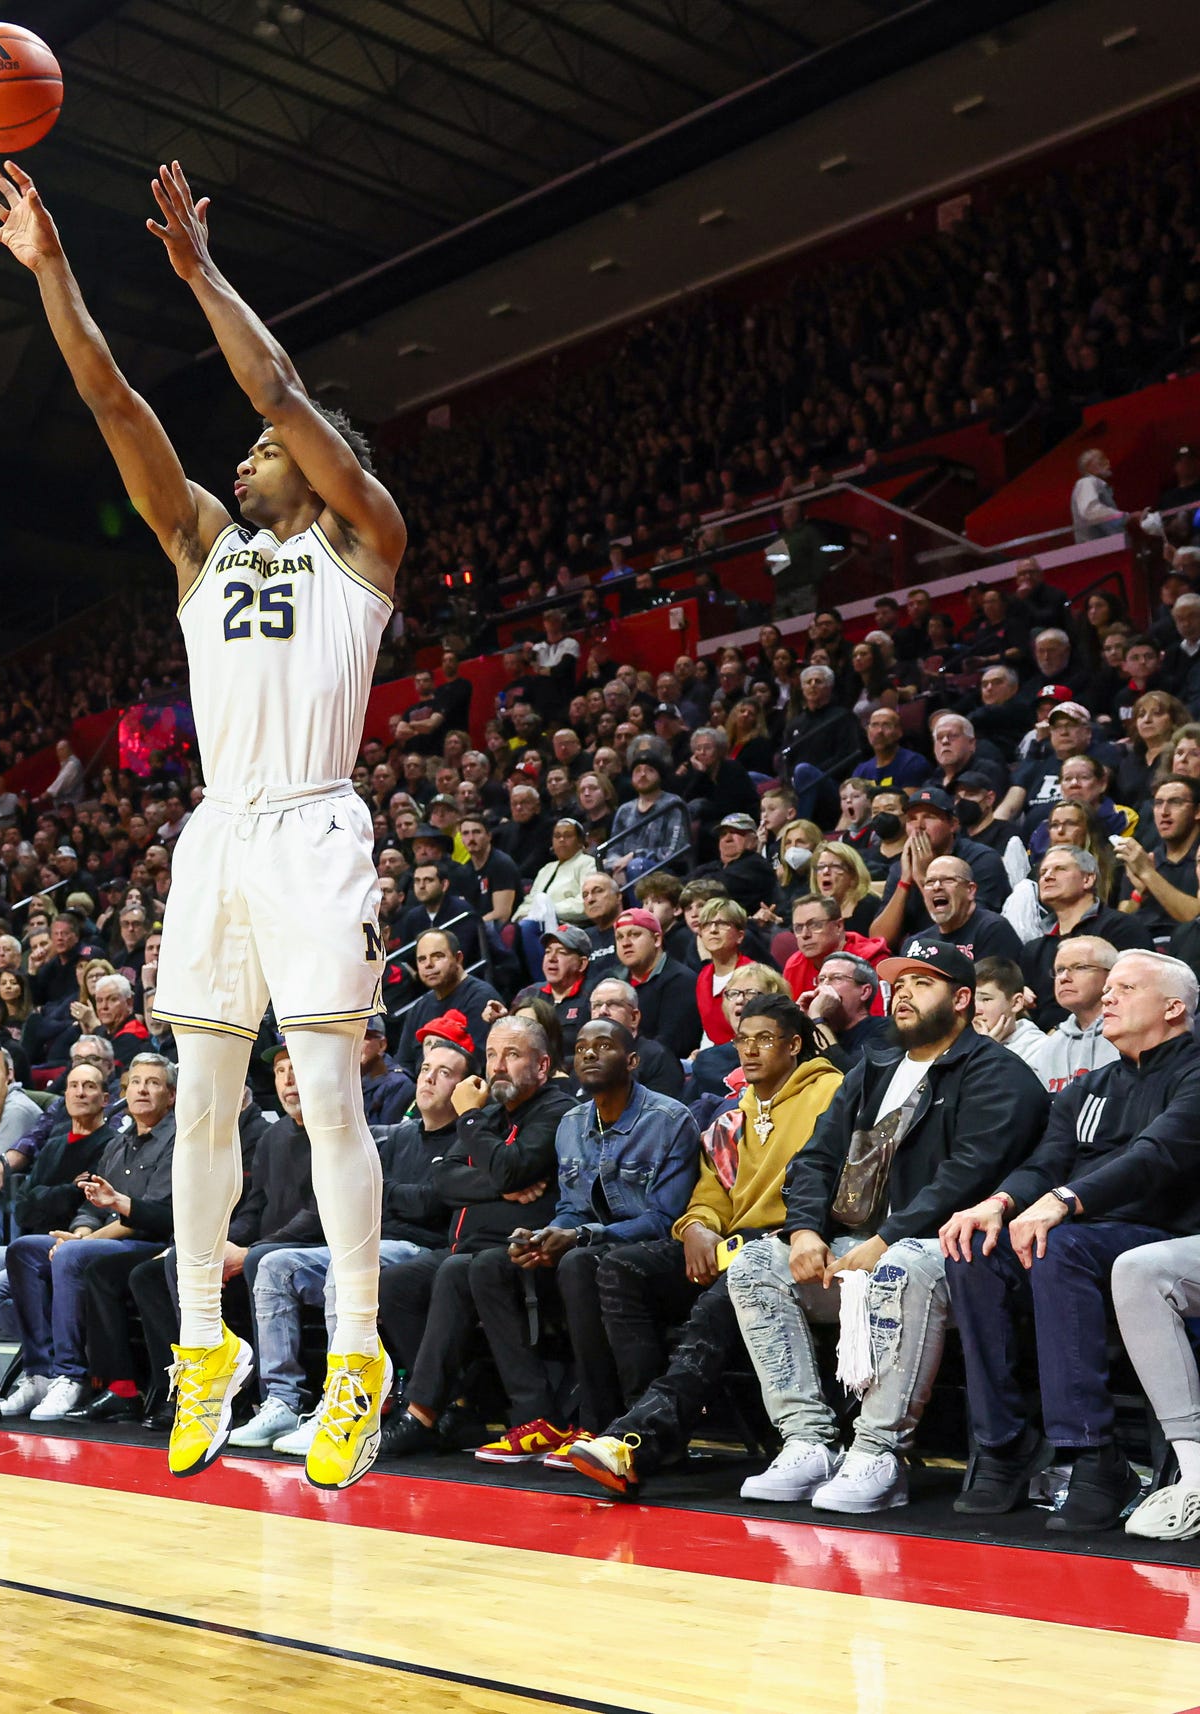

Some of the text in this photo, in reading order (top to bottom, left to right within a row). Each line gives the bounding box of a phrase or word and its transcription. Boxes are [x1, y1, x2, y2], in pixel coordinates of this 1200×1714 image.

[215, 550, 315, 579] MICHIGAN
[223, 581, 296, 642] 25
[1041, 684, 1055, 696] R
